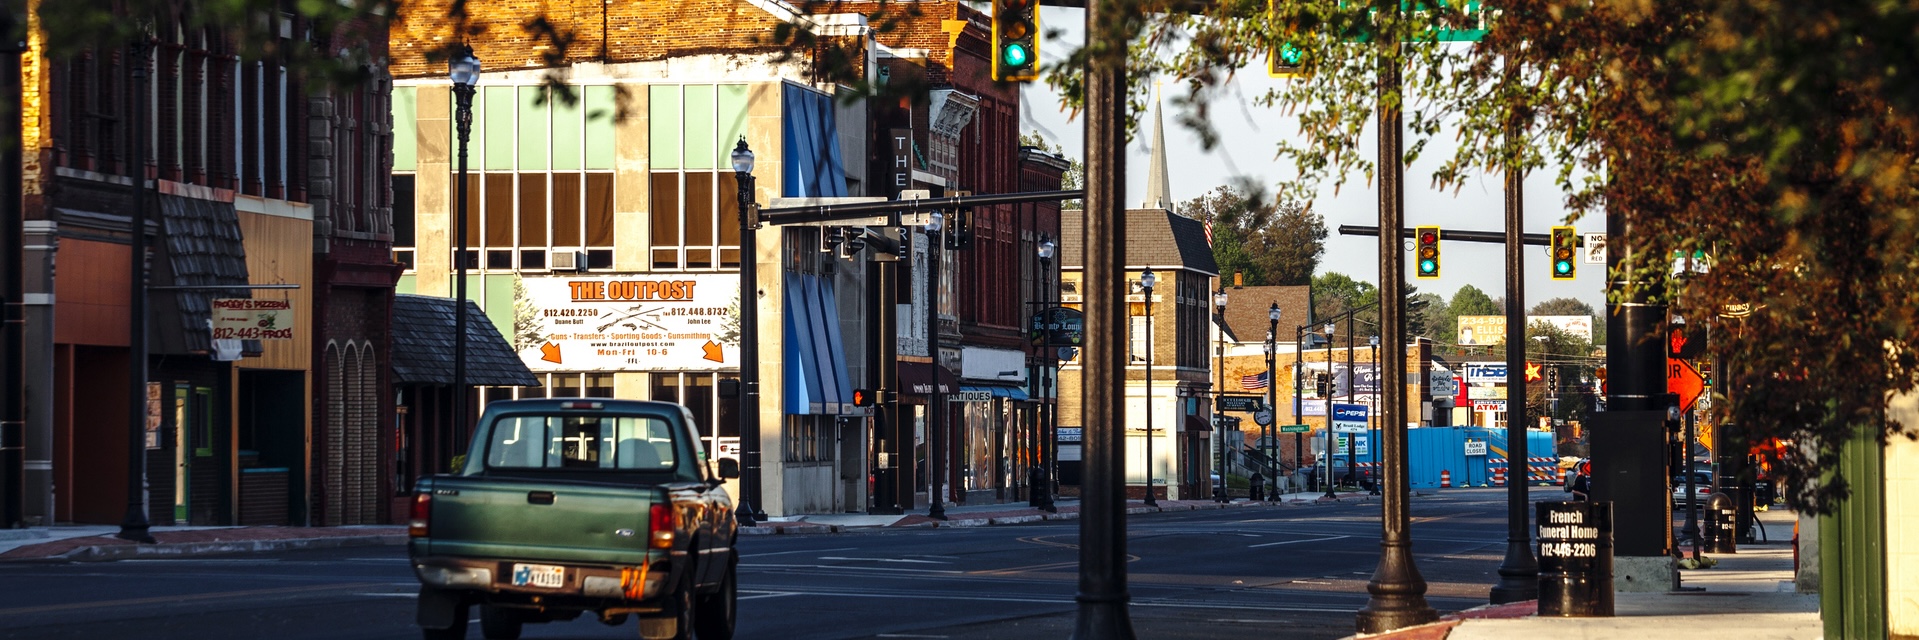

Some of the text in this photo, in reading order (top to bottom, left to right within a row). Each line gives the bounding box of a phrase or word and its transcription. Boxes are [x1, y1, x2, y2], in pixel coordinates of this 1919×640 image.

[568, 280, 696, 300] THE OUTPOST
[543, 309, 599, 317] 812.420.2250
[671, 307, 728, 316] 812.448.8732
[611, 332, 640, 341] Sporting
[668, 332, 711, 341] Gunsmithing
[947, 391, 991, 401] ANTIQUES
[1345, 410, 1367, 418] PEPSI
[1551, 510, 1583, 524] French
[1540, 525, 1599, 539] Funeral Home
